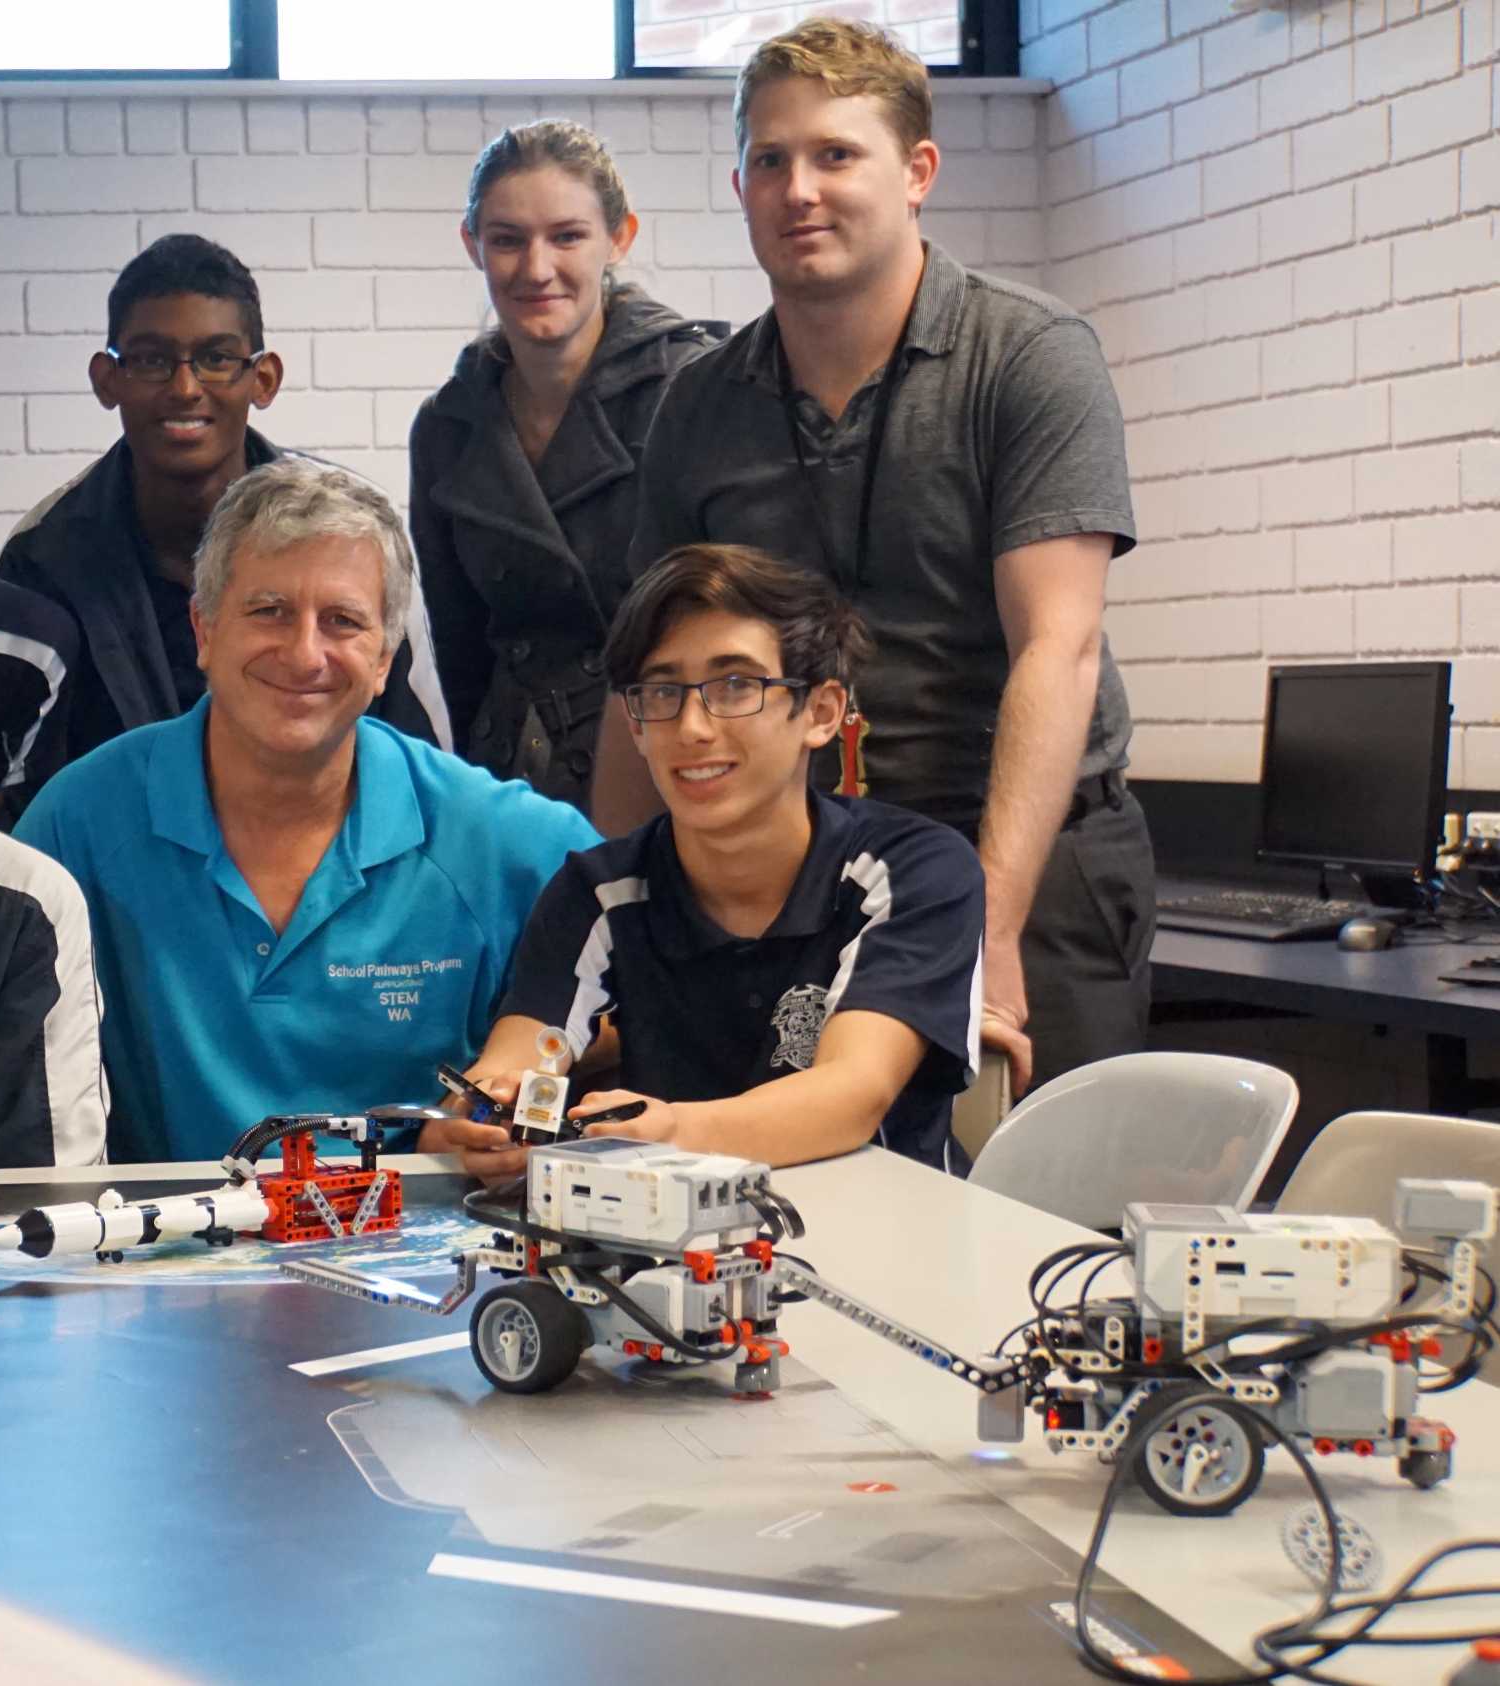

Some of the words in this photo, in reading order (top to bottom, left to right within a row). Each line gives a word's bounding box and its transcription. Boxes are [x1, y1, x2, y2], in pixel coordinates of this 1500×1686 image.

[328, 964, 366, 978] School
[367, 964, 421, 978] Pathways
[379, 991, 419, 1006] STEM
[387, 1007, 412, 1022] WA
